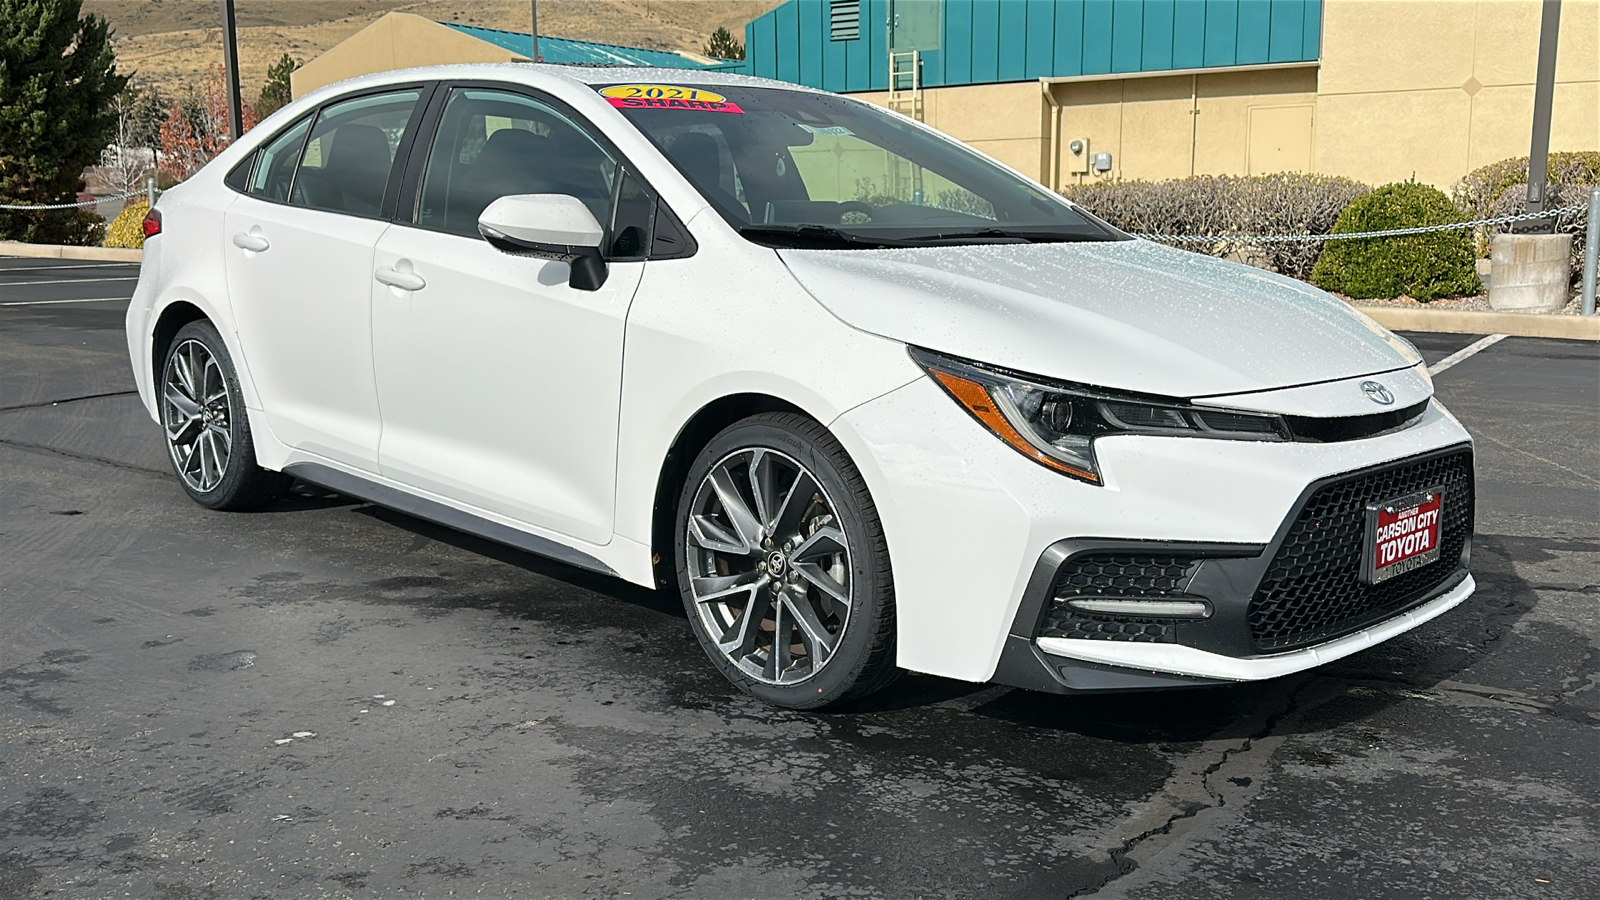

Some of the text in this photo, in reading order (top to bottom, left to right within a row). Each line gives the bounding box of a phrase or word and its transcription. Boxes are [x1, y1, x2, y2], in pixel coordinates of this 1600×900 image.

[625, 87, 698, 100] 2021
[621, 98, 731, 110] SHARP
[1398, 507, 1419, 520] ANOTHER
[1376, 509, 1439, 543] CARSON CITY
[1380, 529, 1429, 564] TOYOTA
[1391, 556, 1421, 575] TOYOTA
